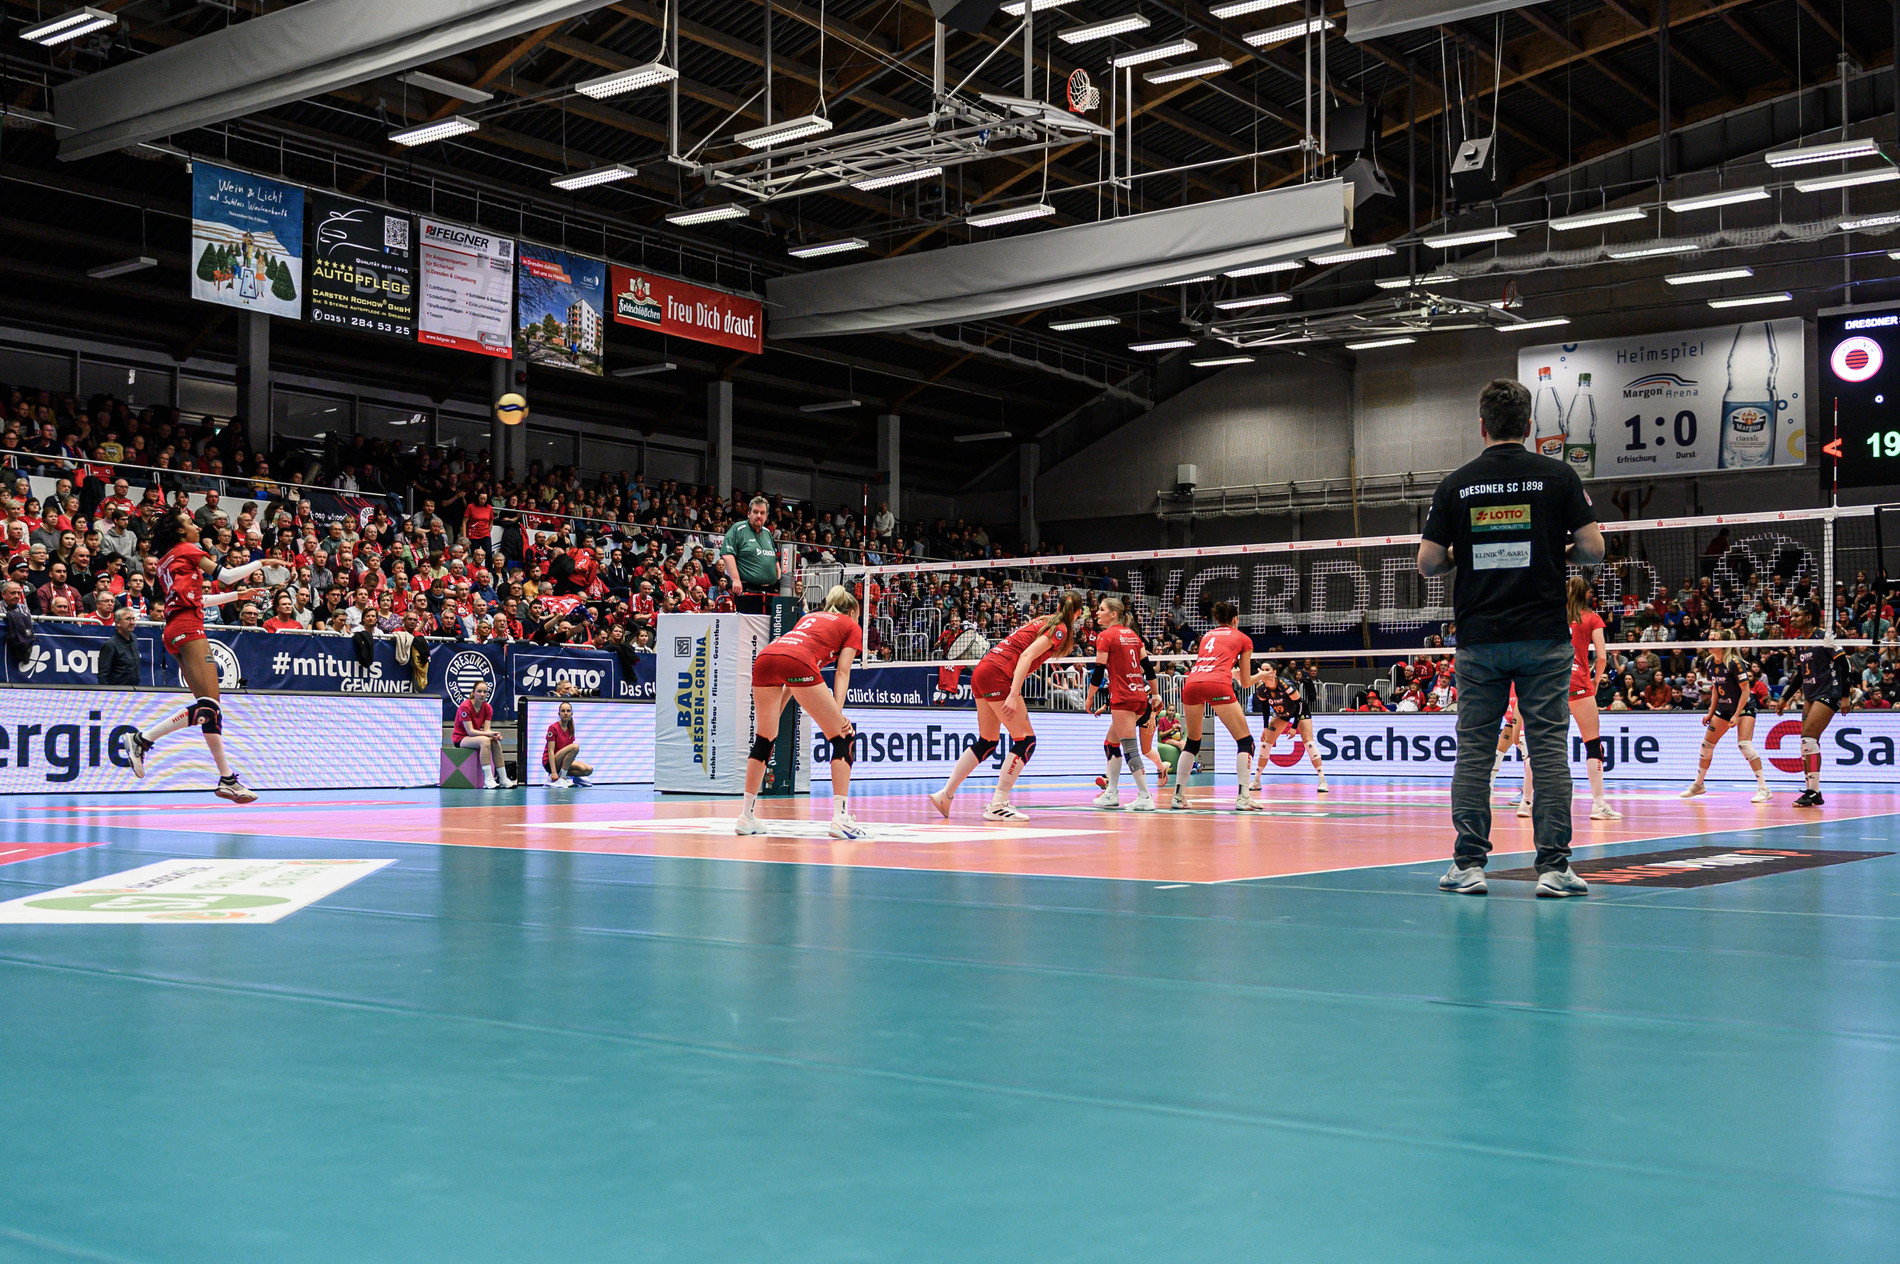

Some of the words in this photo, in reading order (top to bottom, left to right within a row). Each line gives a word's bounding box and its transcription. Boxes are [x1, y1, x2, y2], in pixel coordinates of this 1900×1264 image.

[218, 179, 244, 194] Wein
[247, 188, 255, 198] &
[257, 187, 283, 204] Licht
[436, 227, 490, 249] FELGNER
[314, 266, 410, 295] AUTOPFLEGE
[618, 299, 661, 320] Feldschlößchen
[668, 295, 692, 324] Freu
[696, 302, 720, 331] Dich
[724, 310, 757, 339] drauf.
[324, 314, 346, 324] 0351
[352, 317, 374, 328] 284
[378, 322, 392, 332] 53
[396, 326, 410, 335] 25
[1845, 316, 1898, 330] DRESDNER
[1617, 341, 1704, 364] Heimspiel
[1623, 388, 1662, 398] Margon
[1666, 389, 1698, 398] Arena
[1736, 424, 1761, 432] Margon
[1866, 431, 1900, 458] 19
[1617, 455, 1656, 464] Erfrischung
[1676, 451, 1696, 459] Durst
[1460, 483, 1504, 499] DRESDNER
[1507, 482, 1519, 493] SC
[1522, 481, 1544, 492] 1898
[1490, 510, 1523, 520] LOTTO
[796, 618, 816, 630] 6
[1204, 637, 1216, 653] 4
[56, 648, 100, 674] LOT
[450, 654, 490, 676] DRESDNER
[1130, 648, 1138, 668] 3
[340, 678, 414, 693] GEWINNE
[546, 667, 600, 690] LOTTO
[620, 680, 642, 697] Das
[677, 672, 692, 727] BAU
[694, 636, 707, 764] DRESDEN-GRUNA
[847, 689, 875, 704] Glück
[876, 690, 889, 704] ist
[890, 692, 902, 704] so
[904, 691, 923, 704] nah.
[1274, 706, 1284, 714] 19
[1834, 727, 1900, 766] Sa
